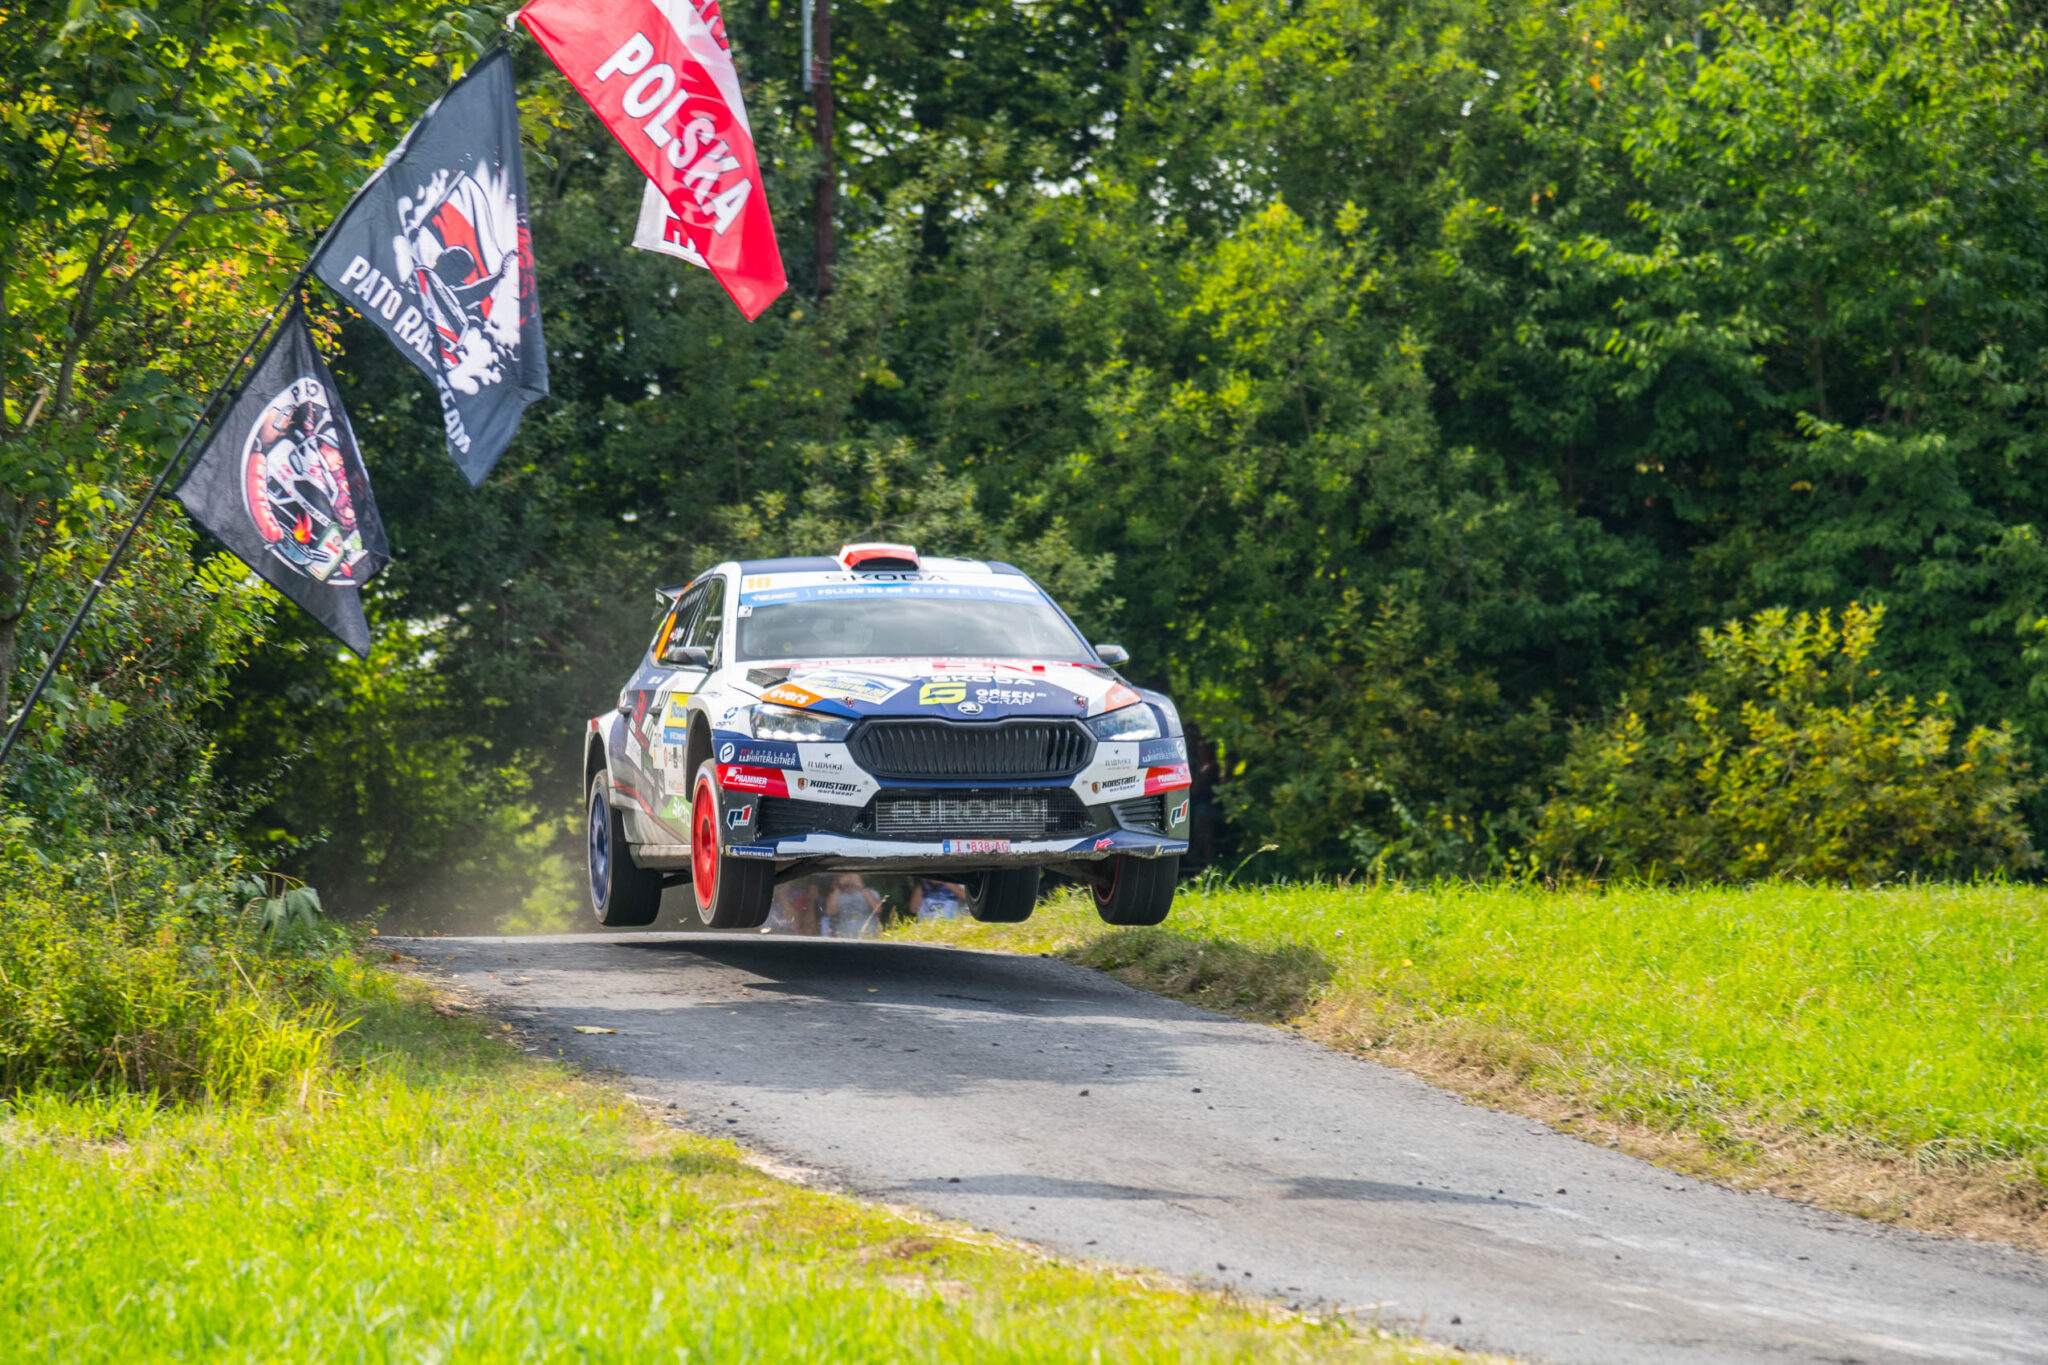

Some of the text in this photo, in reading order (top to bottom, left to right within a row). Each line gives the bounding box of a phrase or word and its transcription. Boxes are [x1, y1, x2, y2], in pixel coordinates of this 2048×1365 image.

[594, 31, 753, 236] POLSKA
[339, 255, 403, 321] PATO
[817, 587, 864, 596] FOLLOW
[769, 689, 809, 704] evers
[974, 688, 1035, 699] GREEN
[976, 696, 1033, 706] SCRAP
[748, 755, 796, 766] HINTERLEITNER
[734, 774, 768, 785] PRAMMER
